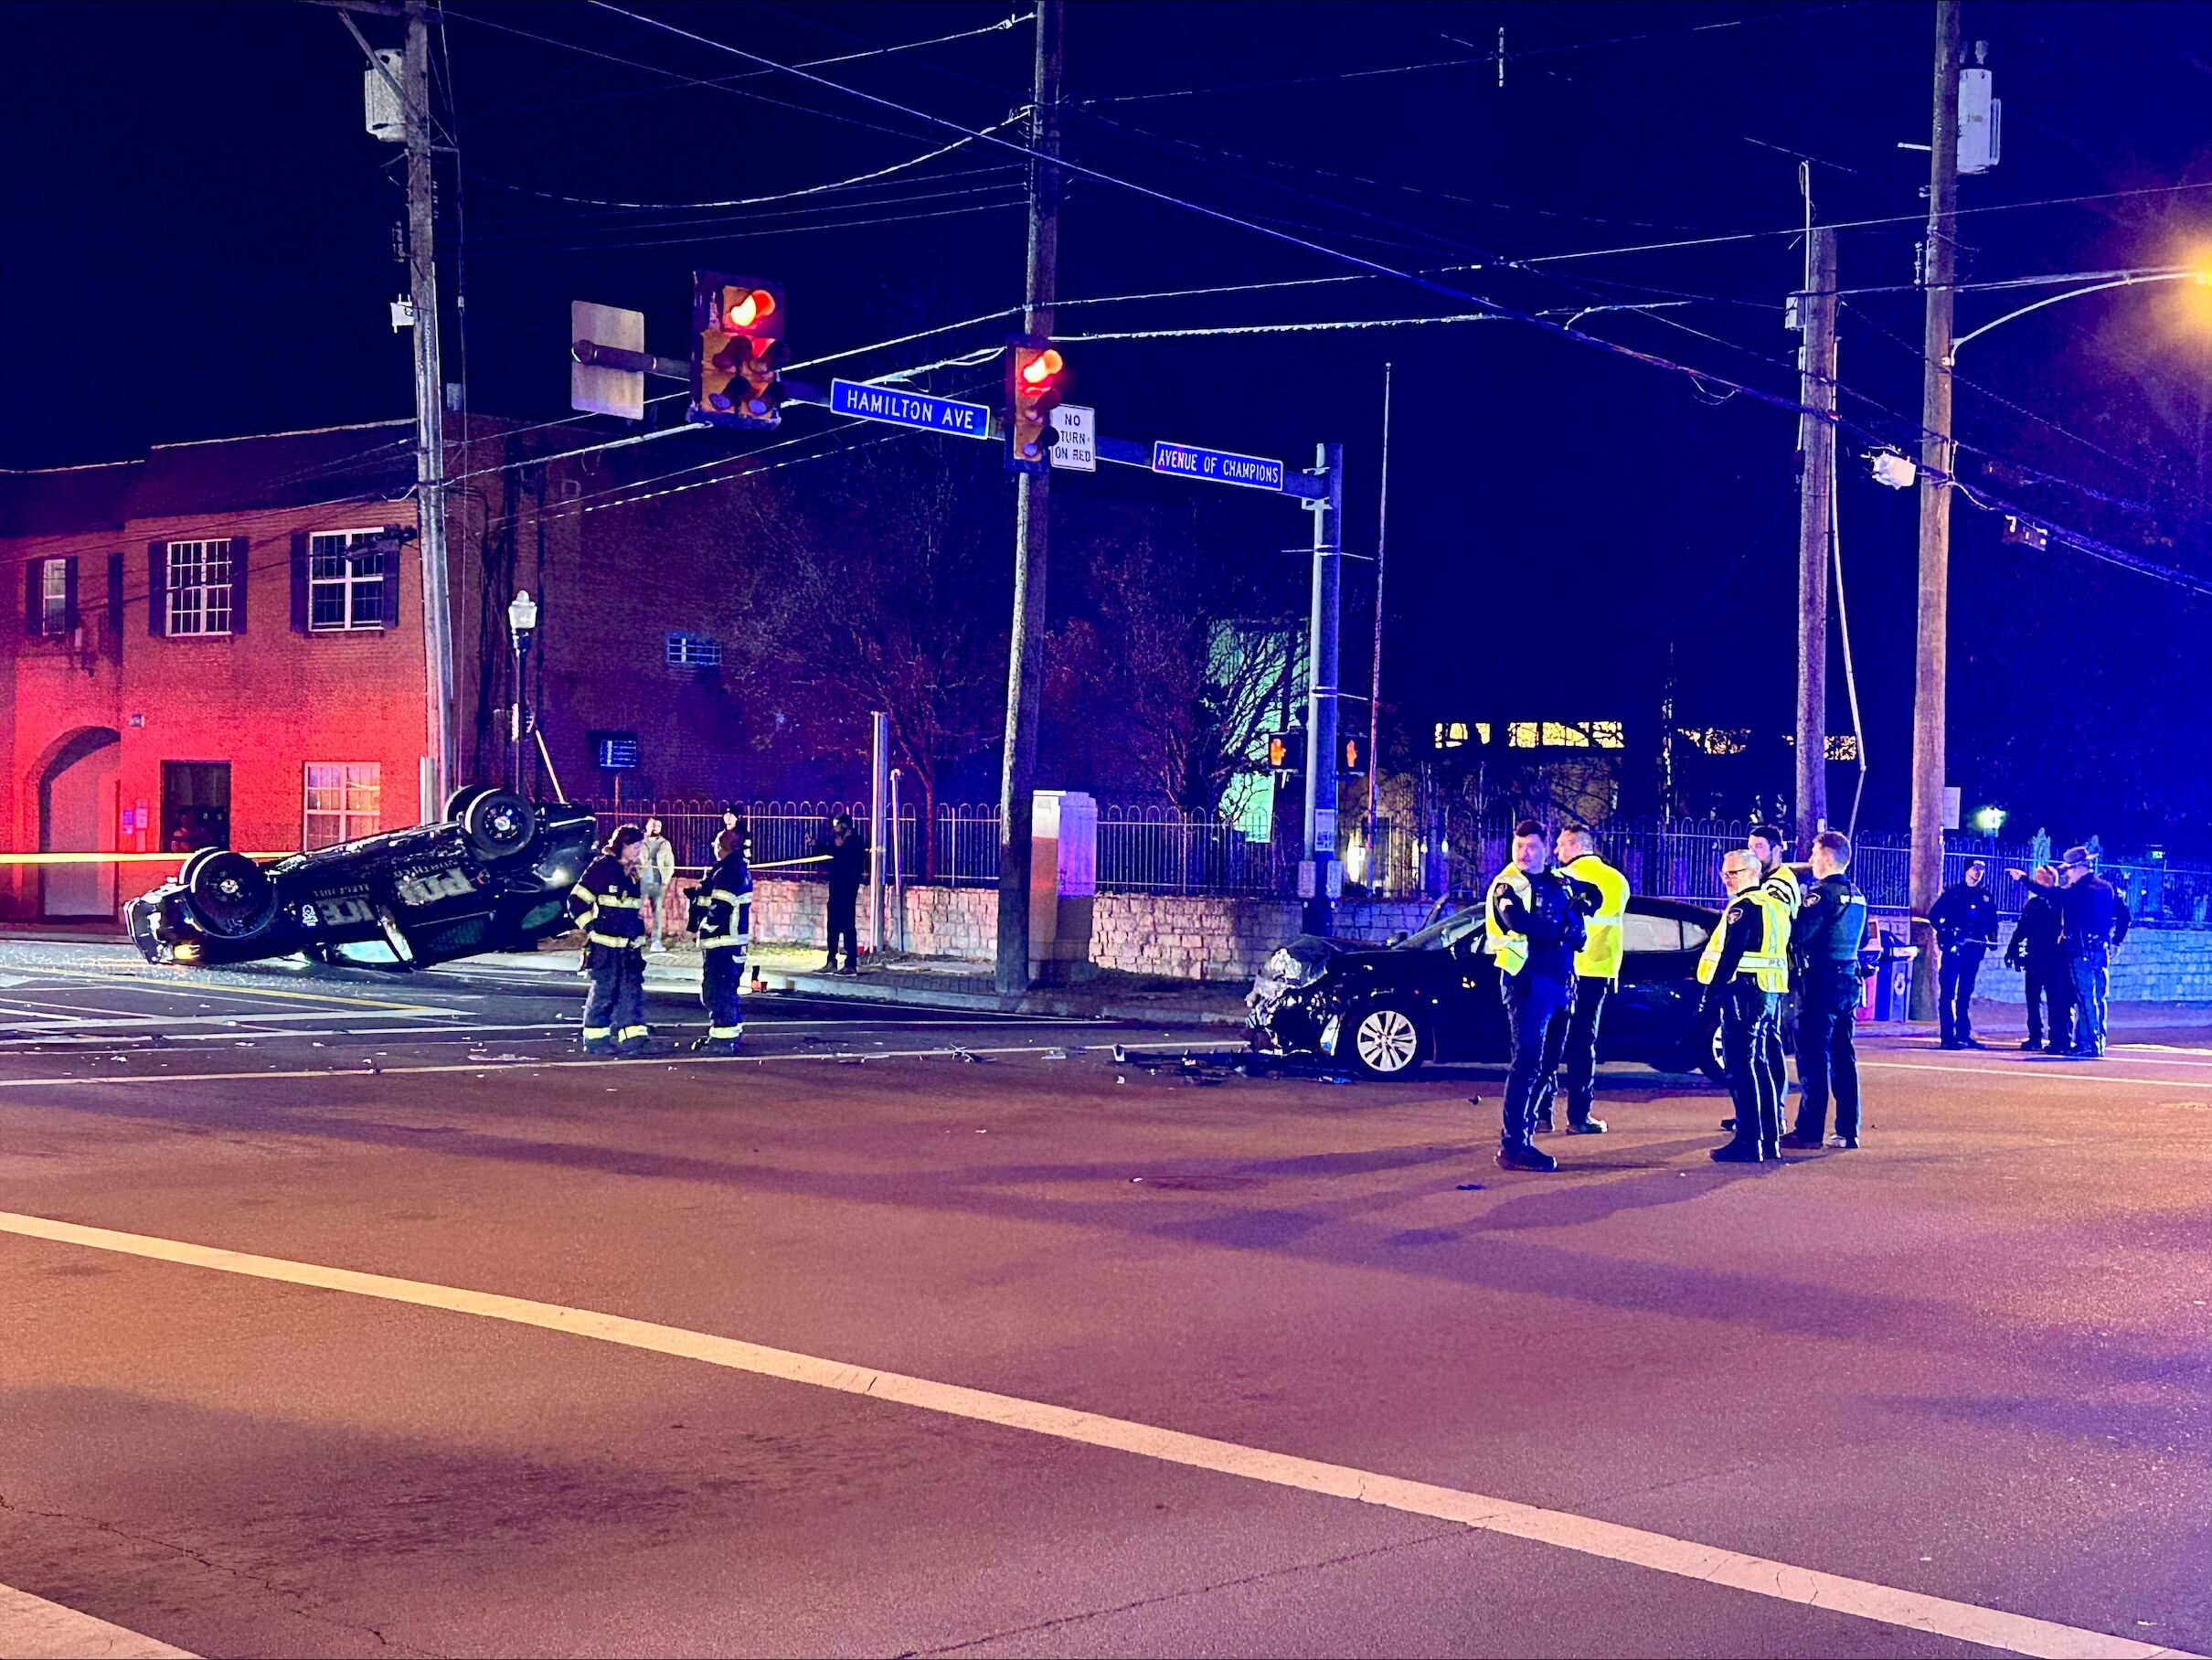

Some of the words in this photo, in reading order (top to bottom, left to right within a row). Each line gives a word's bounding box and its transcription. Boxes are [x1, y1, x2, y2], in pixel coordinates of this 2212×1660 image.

[847, 389, 932, 421] HAMILTON
[941, 408, 974, 430] AVE
[1065, 414, 1080, 426] NO
[1060, 431, 1085, 444] TURN
[1055, 446, 1068, 460] ON
[1073, 449, 1090, 462] RED
[1158, 449, 1197, 471] AVENUE
[1204, 456, 1218, 474] OF
[1223, 459, 1279, 484] CHAMPIONS
